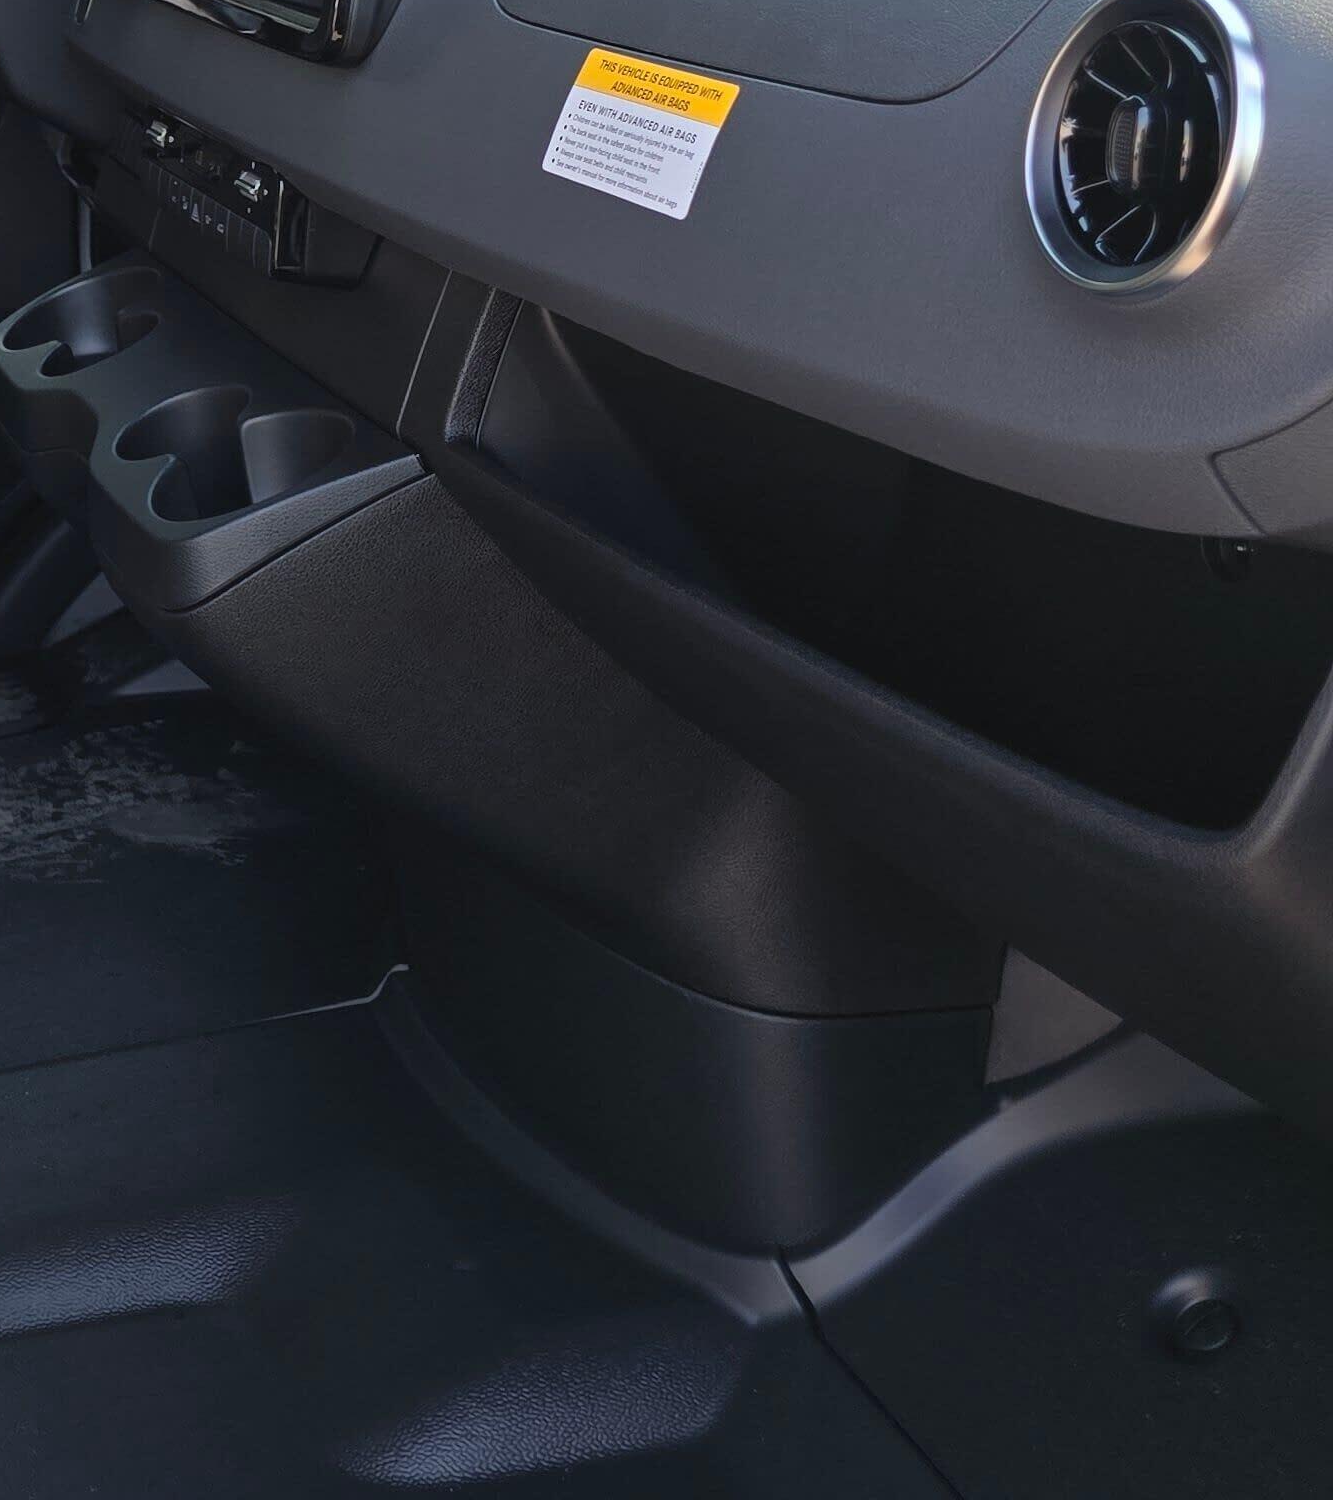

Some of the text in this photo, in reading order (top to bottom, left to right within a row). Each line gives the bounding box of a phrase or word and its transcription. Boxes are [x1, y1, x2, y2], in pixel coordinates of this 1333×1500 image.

[599, 59, 722, 101] THIS VEHICLE IS EQUIPPED WITH
[610, 80, 690, 111] ADVANCED AIR BAGS
[578, 99, 697, 143] EVEN WITH ADVANCED AIR BAGS
